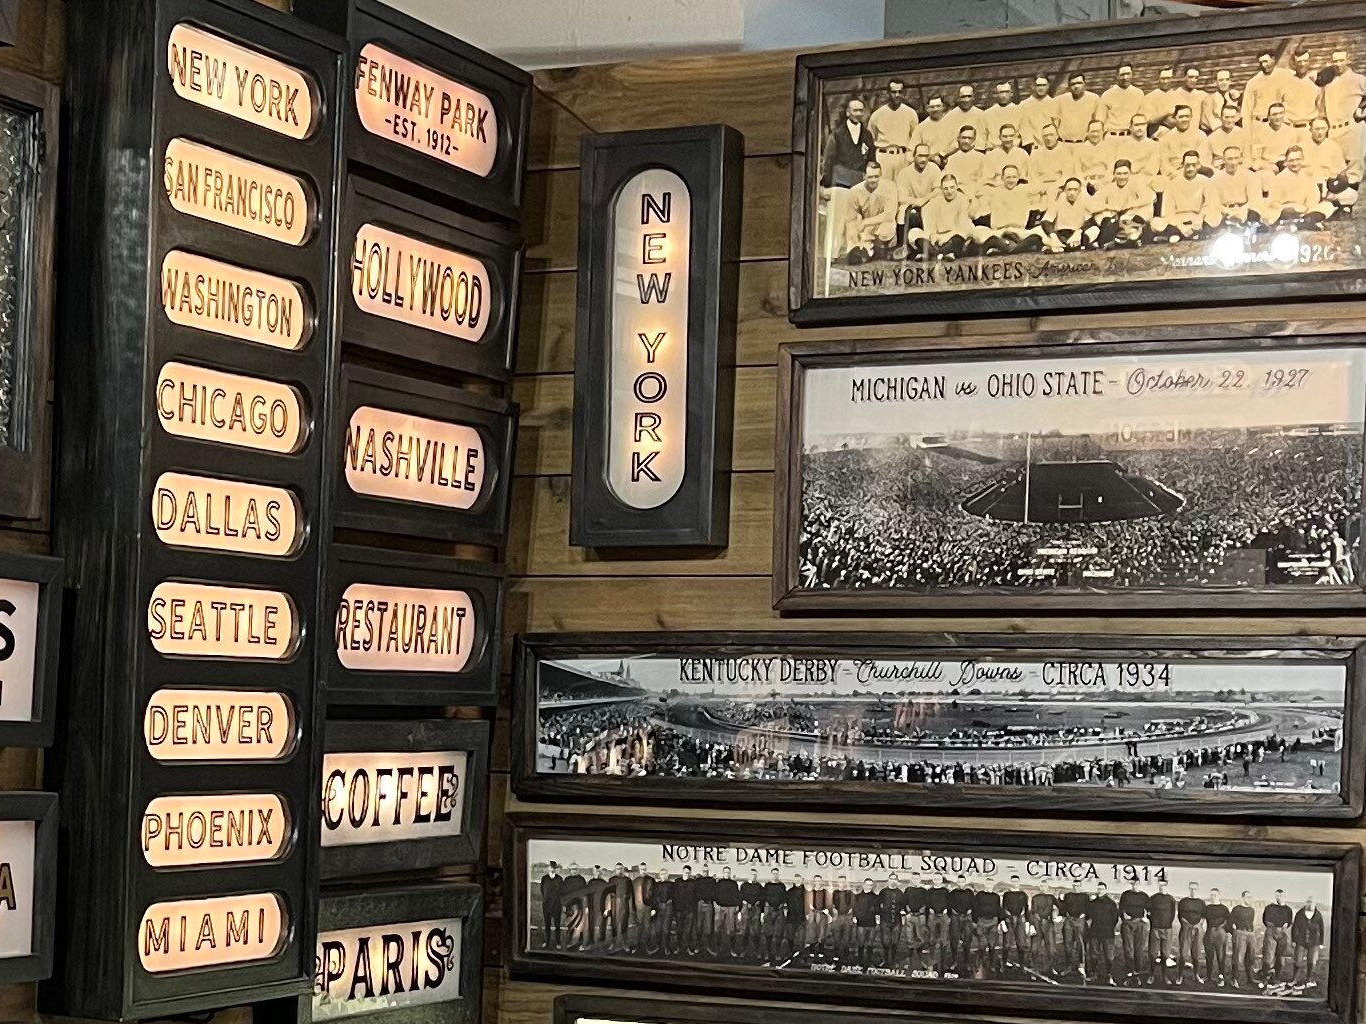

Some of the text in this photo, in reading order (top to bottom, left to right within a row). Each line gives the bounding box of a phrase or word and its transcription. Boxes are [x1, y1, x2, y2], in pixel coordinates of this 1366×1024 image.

[170, 43, 299, 127] NEW YORK
[355, 55, 489, 144] FENWAY PARK
[165, 156, 295, 231] SAN FRANCISCO
[637, 191, 672, 305] NEW
[848, 269, 884, 288] NEW
[892, 266, 936, 286] YORK
[944, 261, 1024, 284] YANKEES
[161, 268, 292, 337] WASHINGTON
[351, 236, 483, 329] HOLLYWOOD
[157, 378, 288, 438] CHICAGO
[631, 331, 669, 483] YORK
[851, 375, 946, 402] MICHIGAN
[987, 372, 1035, 398] OHIO
[1042, 370, 1105, 397] STATE
[1263, 367, 1311, 389] 1927
[344, 425, 479, 491] NASHVILLE
[156, 487, 281, 541] DALLAS
[149, 597, 279, 645] SEATTLE
[336, 598, 467, 655] RESTAURANT
[679, 658, 1171, 687] KENTUCKY DERBY Churchill Downs CIRCA 1934
[149, 704, 274, 745] DENVER
[323, 764, 456, 830] COFFEE
[143, 808, 274, 852] PHOENIX
[661, 844, 1169, 884] NOTRE DAME FOOTBALL SQUAD CIRCA 1914
[144, 908, 266, 956] MIAMI
[320, 927, 451, 999] PARIS
